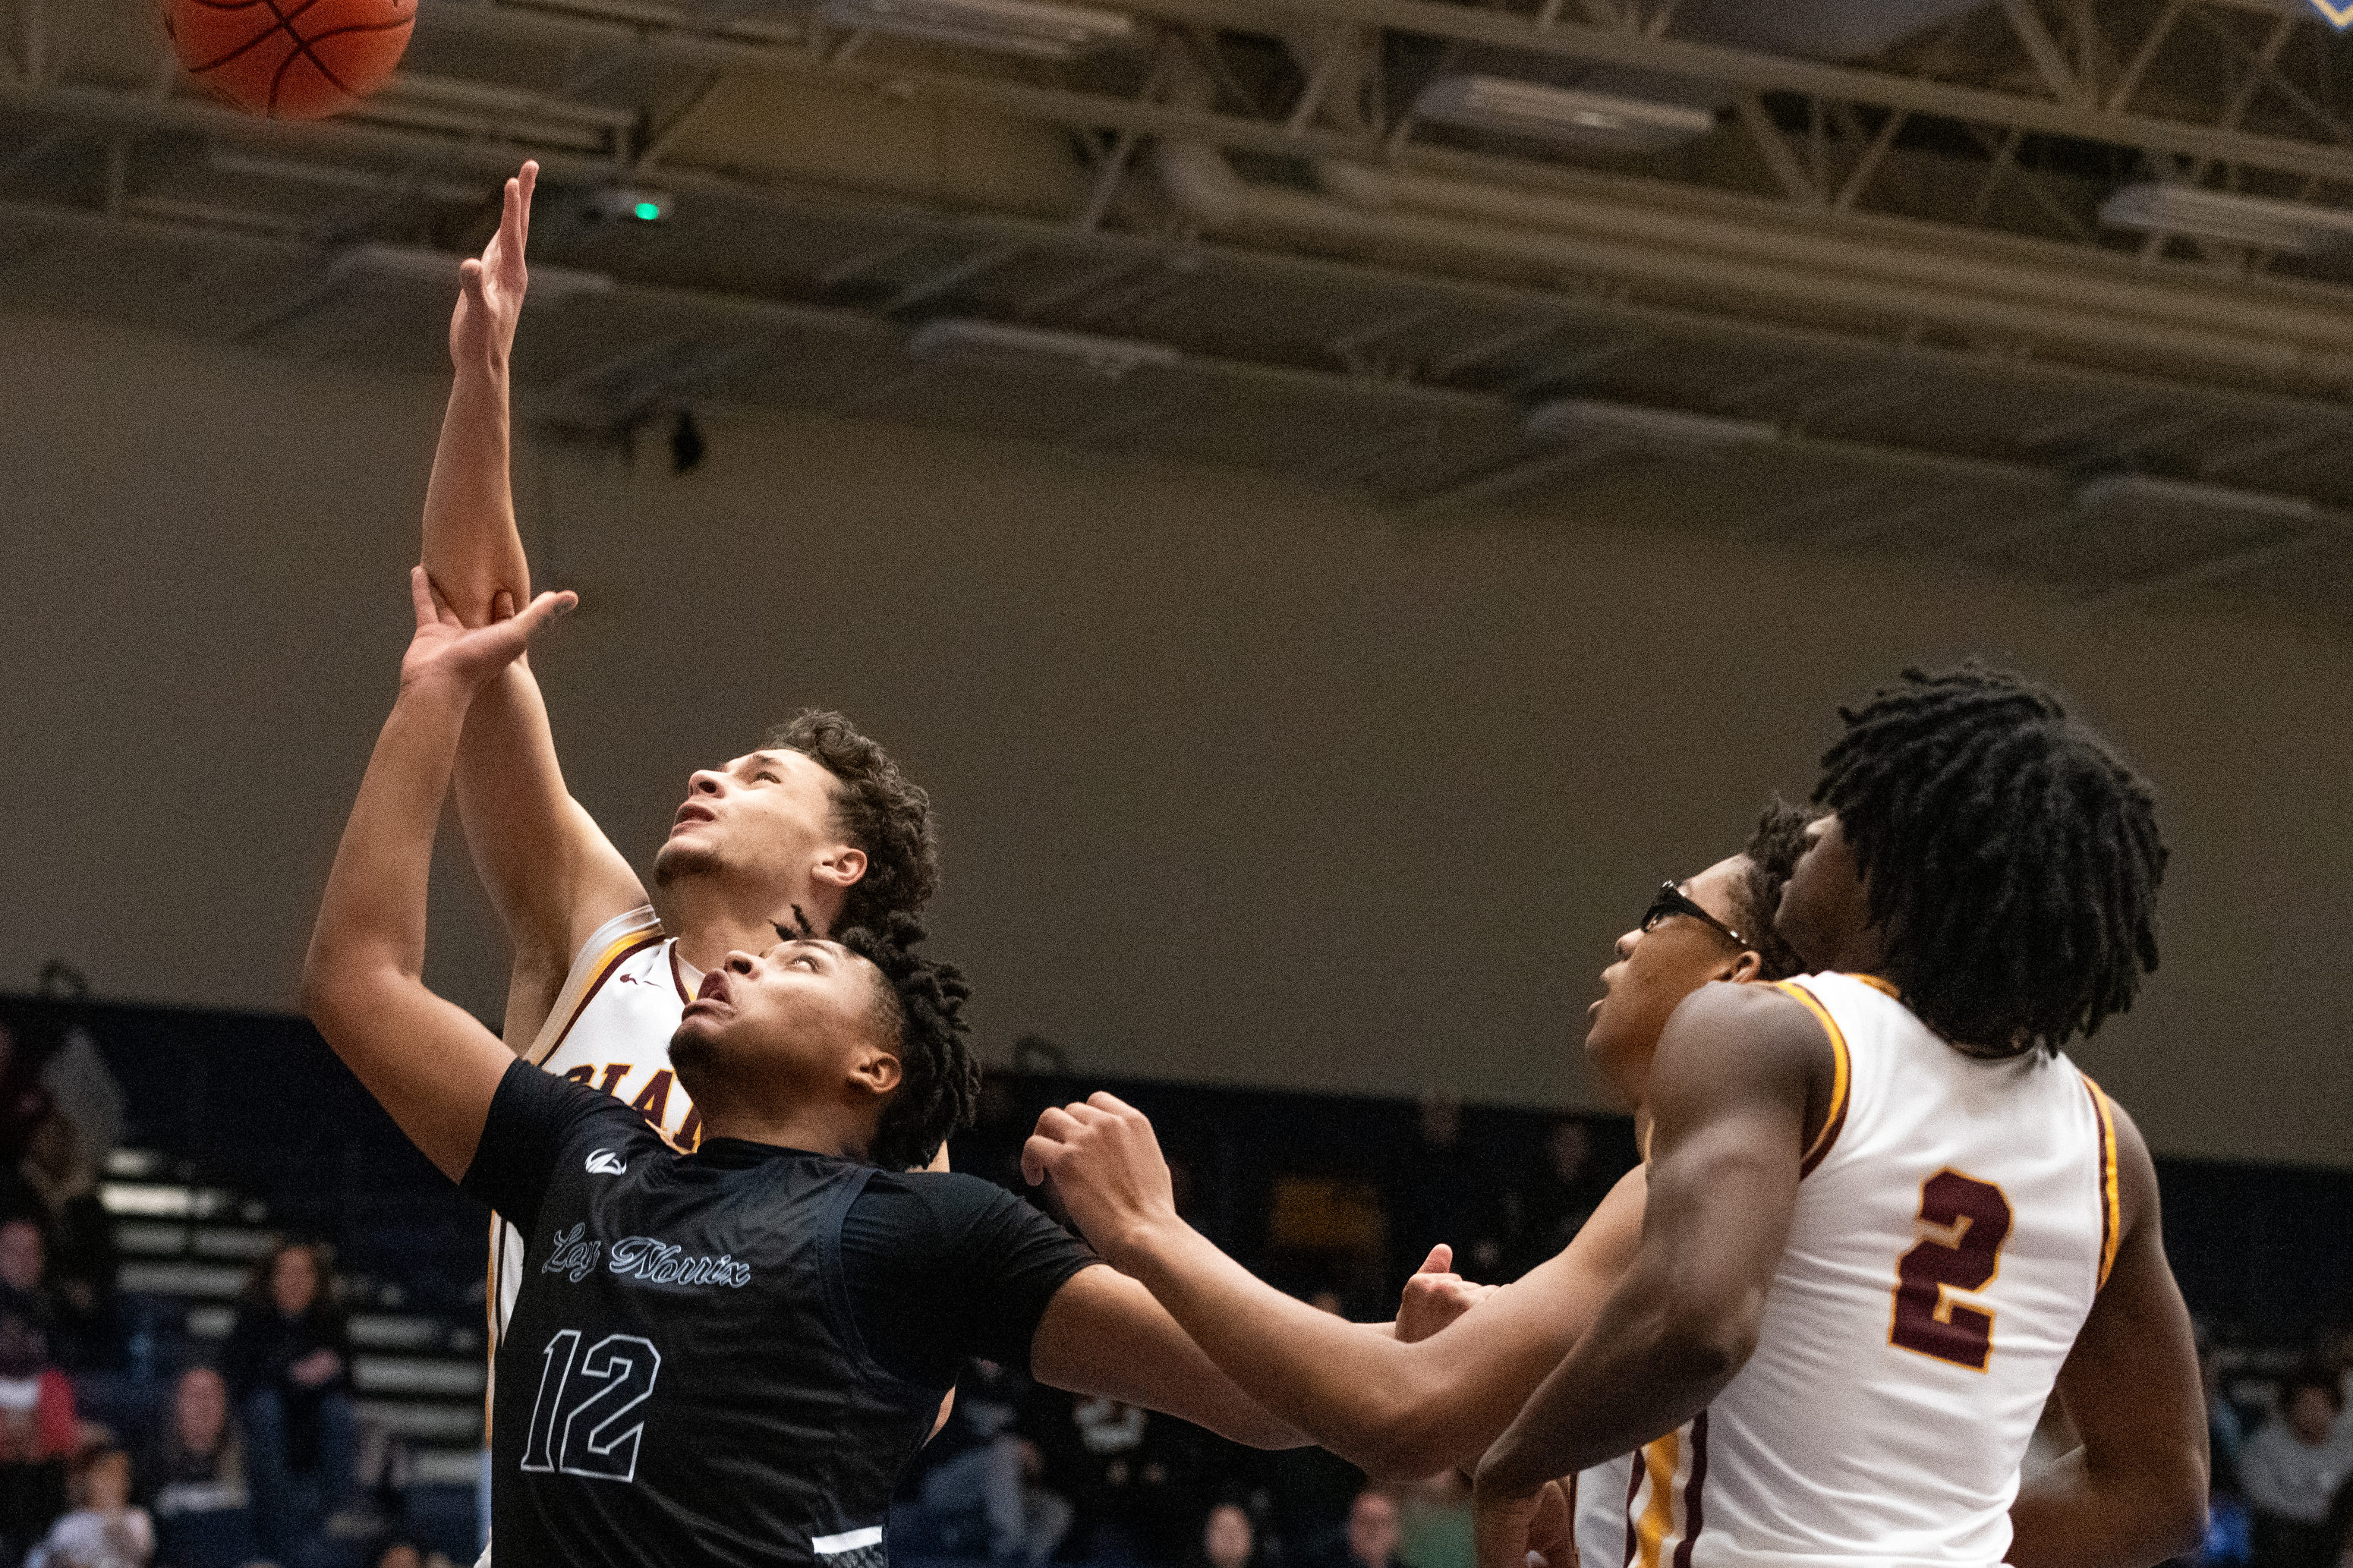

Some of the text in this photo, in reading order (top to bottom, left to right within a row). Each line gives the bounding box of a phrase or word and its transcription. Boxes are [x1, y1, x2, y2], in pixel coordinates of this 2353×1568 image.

[610, 1235, 751, 1288] Norrix
[1888, 1166, 2014, 1374] 2
[520, 1328, 661, 1484] 12
